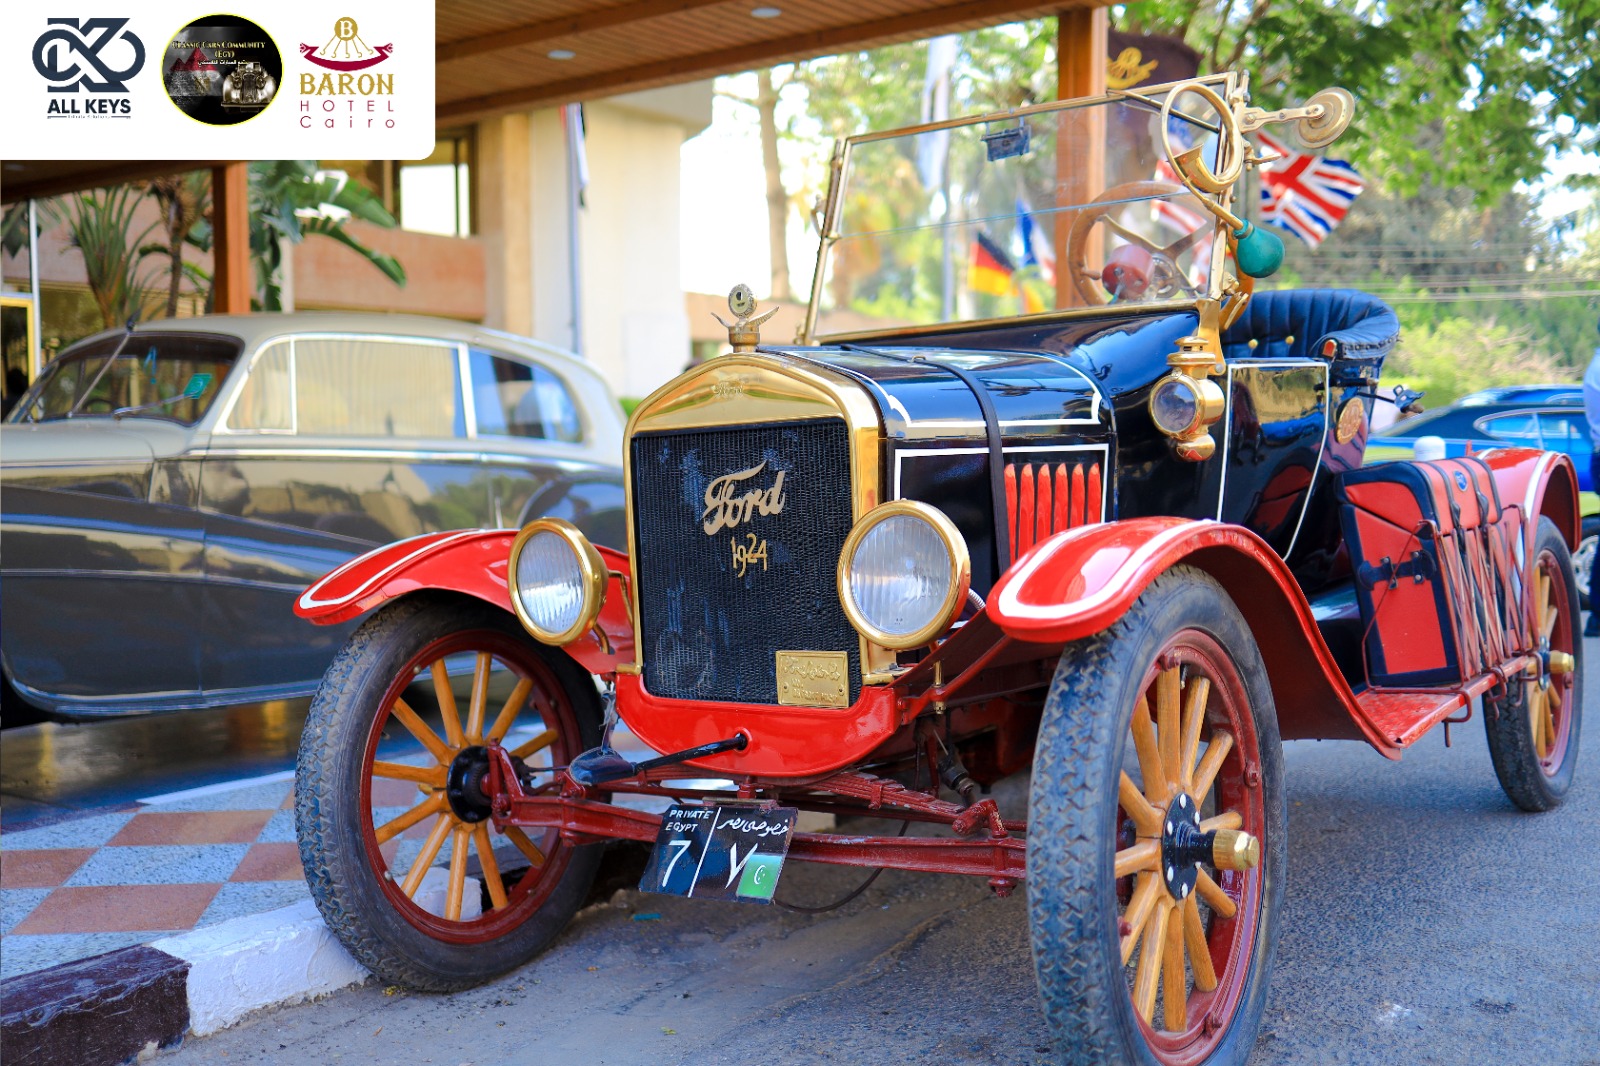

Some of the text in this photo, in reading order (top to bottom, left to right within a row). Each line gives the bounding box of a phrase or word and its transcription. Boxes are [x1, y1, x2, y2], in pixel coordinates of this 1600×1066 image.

[702, 459, 786, 536] Ford
[730, 532, 768, 578] 1924
[665, 821, 699, 833] EGYPT
[669, 809, 714, 820] PRIVATE
[662, 840, 692, 888] 7
